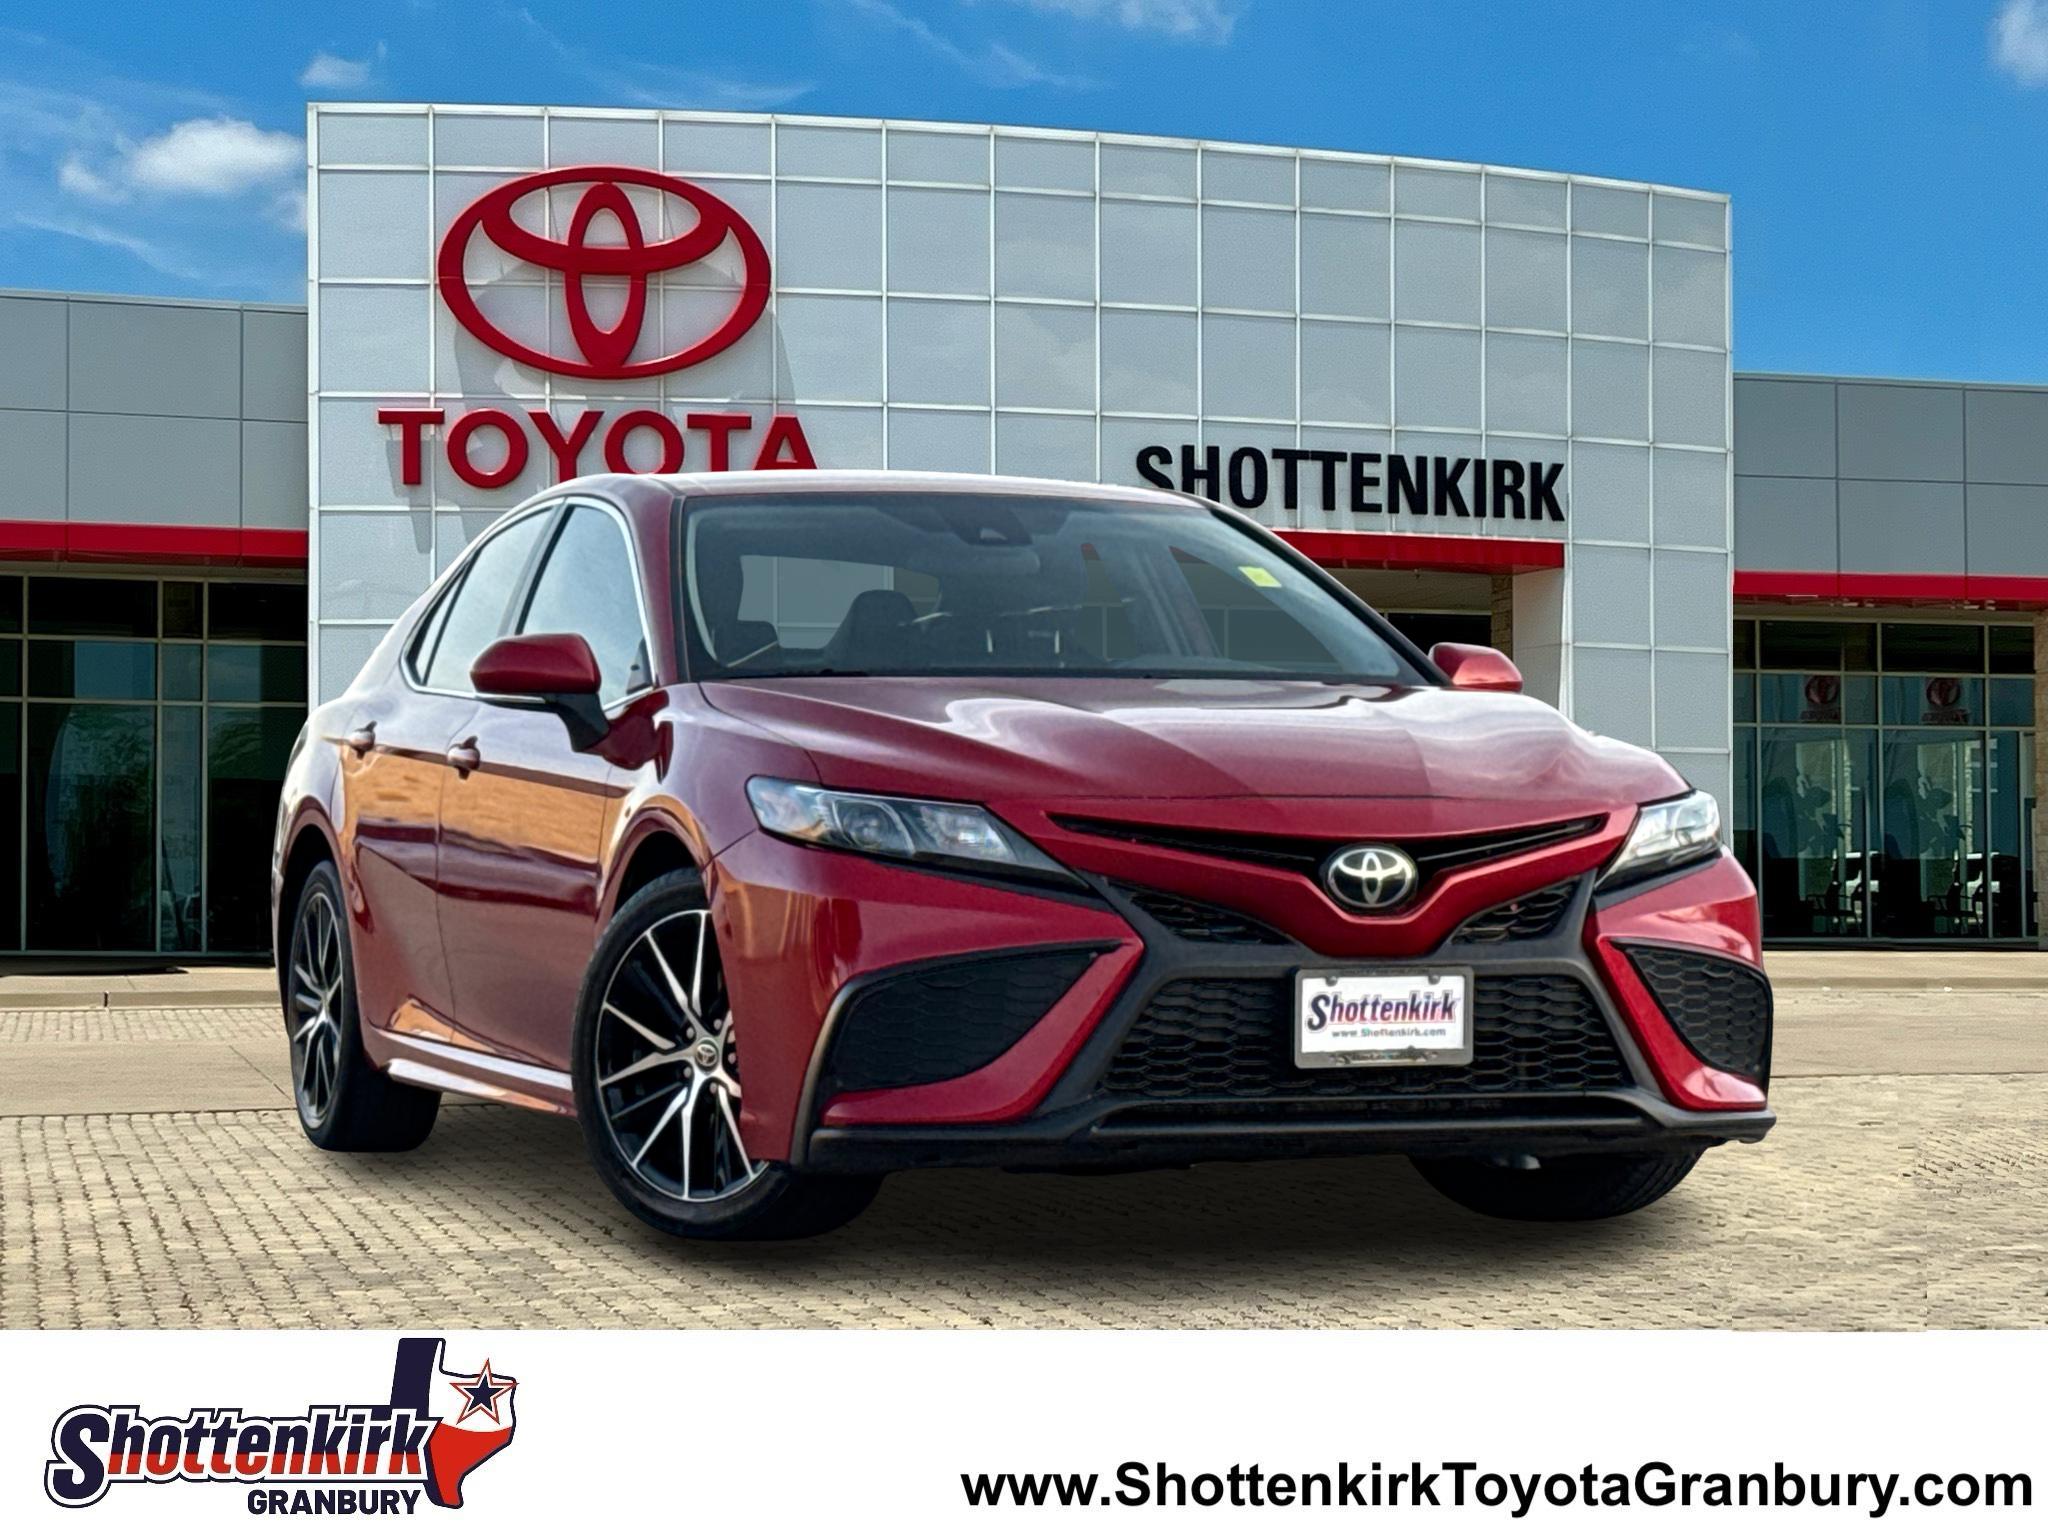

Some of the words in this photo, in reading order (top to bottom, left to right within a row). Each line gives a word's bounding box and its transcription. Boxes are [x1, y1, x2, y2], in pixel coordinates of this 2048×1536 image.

[377, 407, 818, 489] TOYOTA
[1136, 444, 1565, 522] SHOTTENKIRK
[1306, 991, 1458, 1031] Shottenkirk
